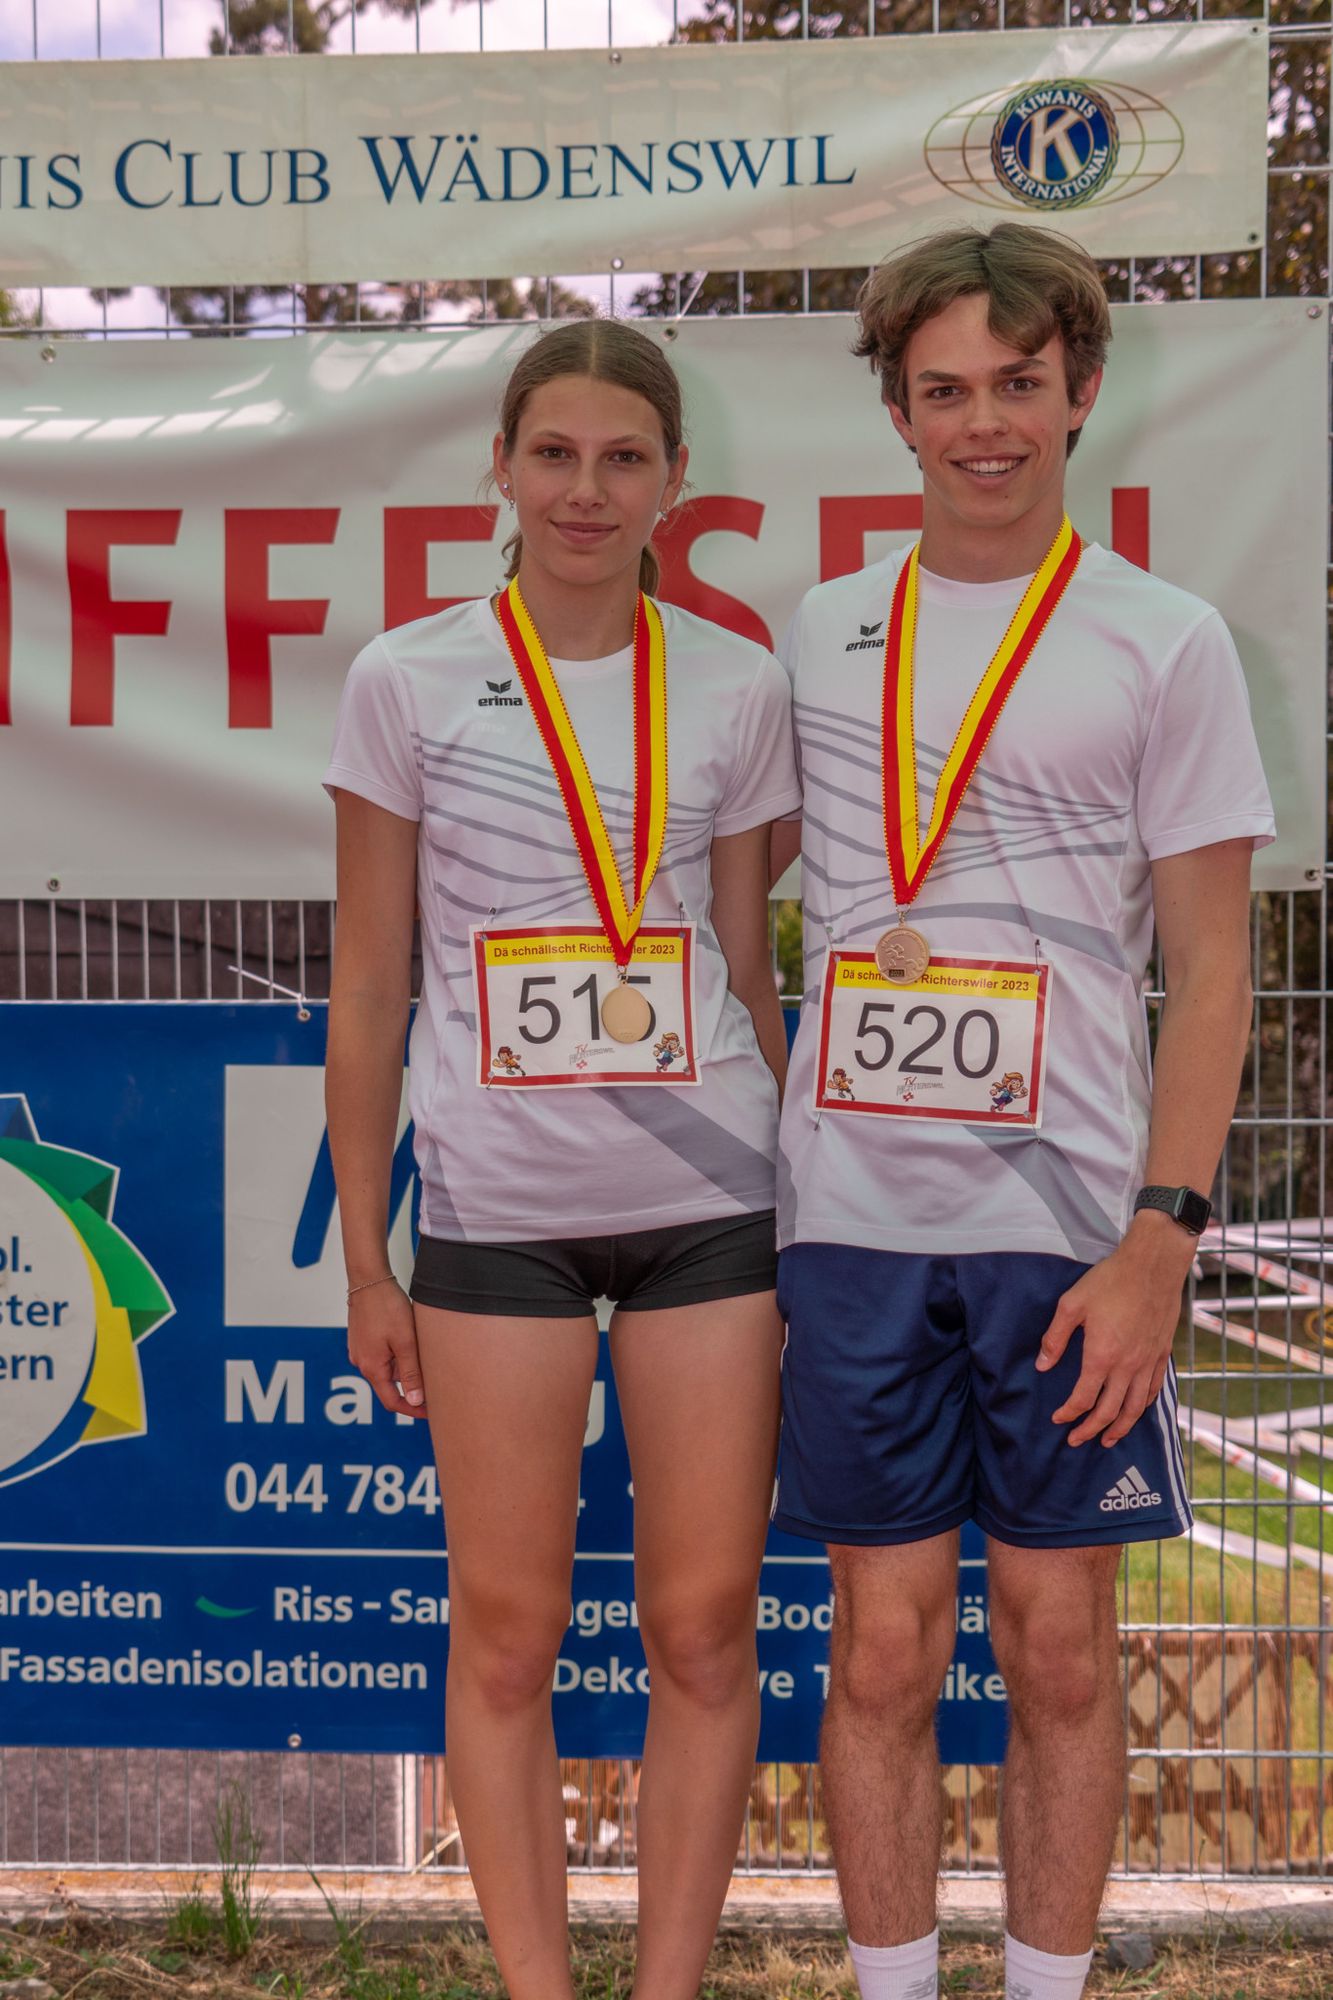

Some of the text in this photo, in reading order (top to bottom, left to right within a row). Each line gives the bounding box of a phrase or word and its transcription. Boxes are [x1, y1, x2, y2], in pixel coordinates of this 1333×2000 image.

[1016, 91, 1097, 120] KIWANIS
[0, 133, 857, 210] IS CLUB WÄDENSWIL
[1001, 145, 1109, 200] INTERNATIONAL
[845, 637, 886, 652] erima
[477, 694, 524, 707] erima
[494, 947, 509, 958] Dä
[512, 944, 577, 957] schnällscht
[650, 944, 675, 955] 2023
[842, 969, 855, 979] Dä
[922, 974, 998, 989] Richterswiler
[1002, 979, 1030, 991] 2023
[854, 1001, 999, 1079] 520
[0, 1295, 69, 1327] ter
[225, 1462, 441, 1515] 044 784
[1100, 1492, 1162, 1512] adidas
[273, 1586, 353, 1623] Riss
[0, 1648, 427, 1690] Fassadenisolationen
